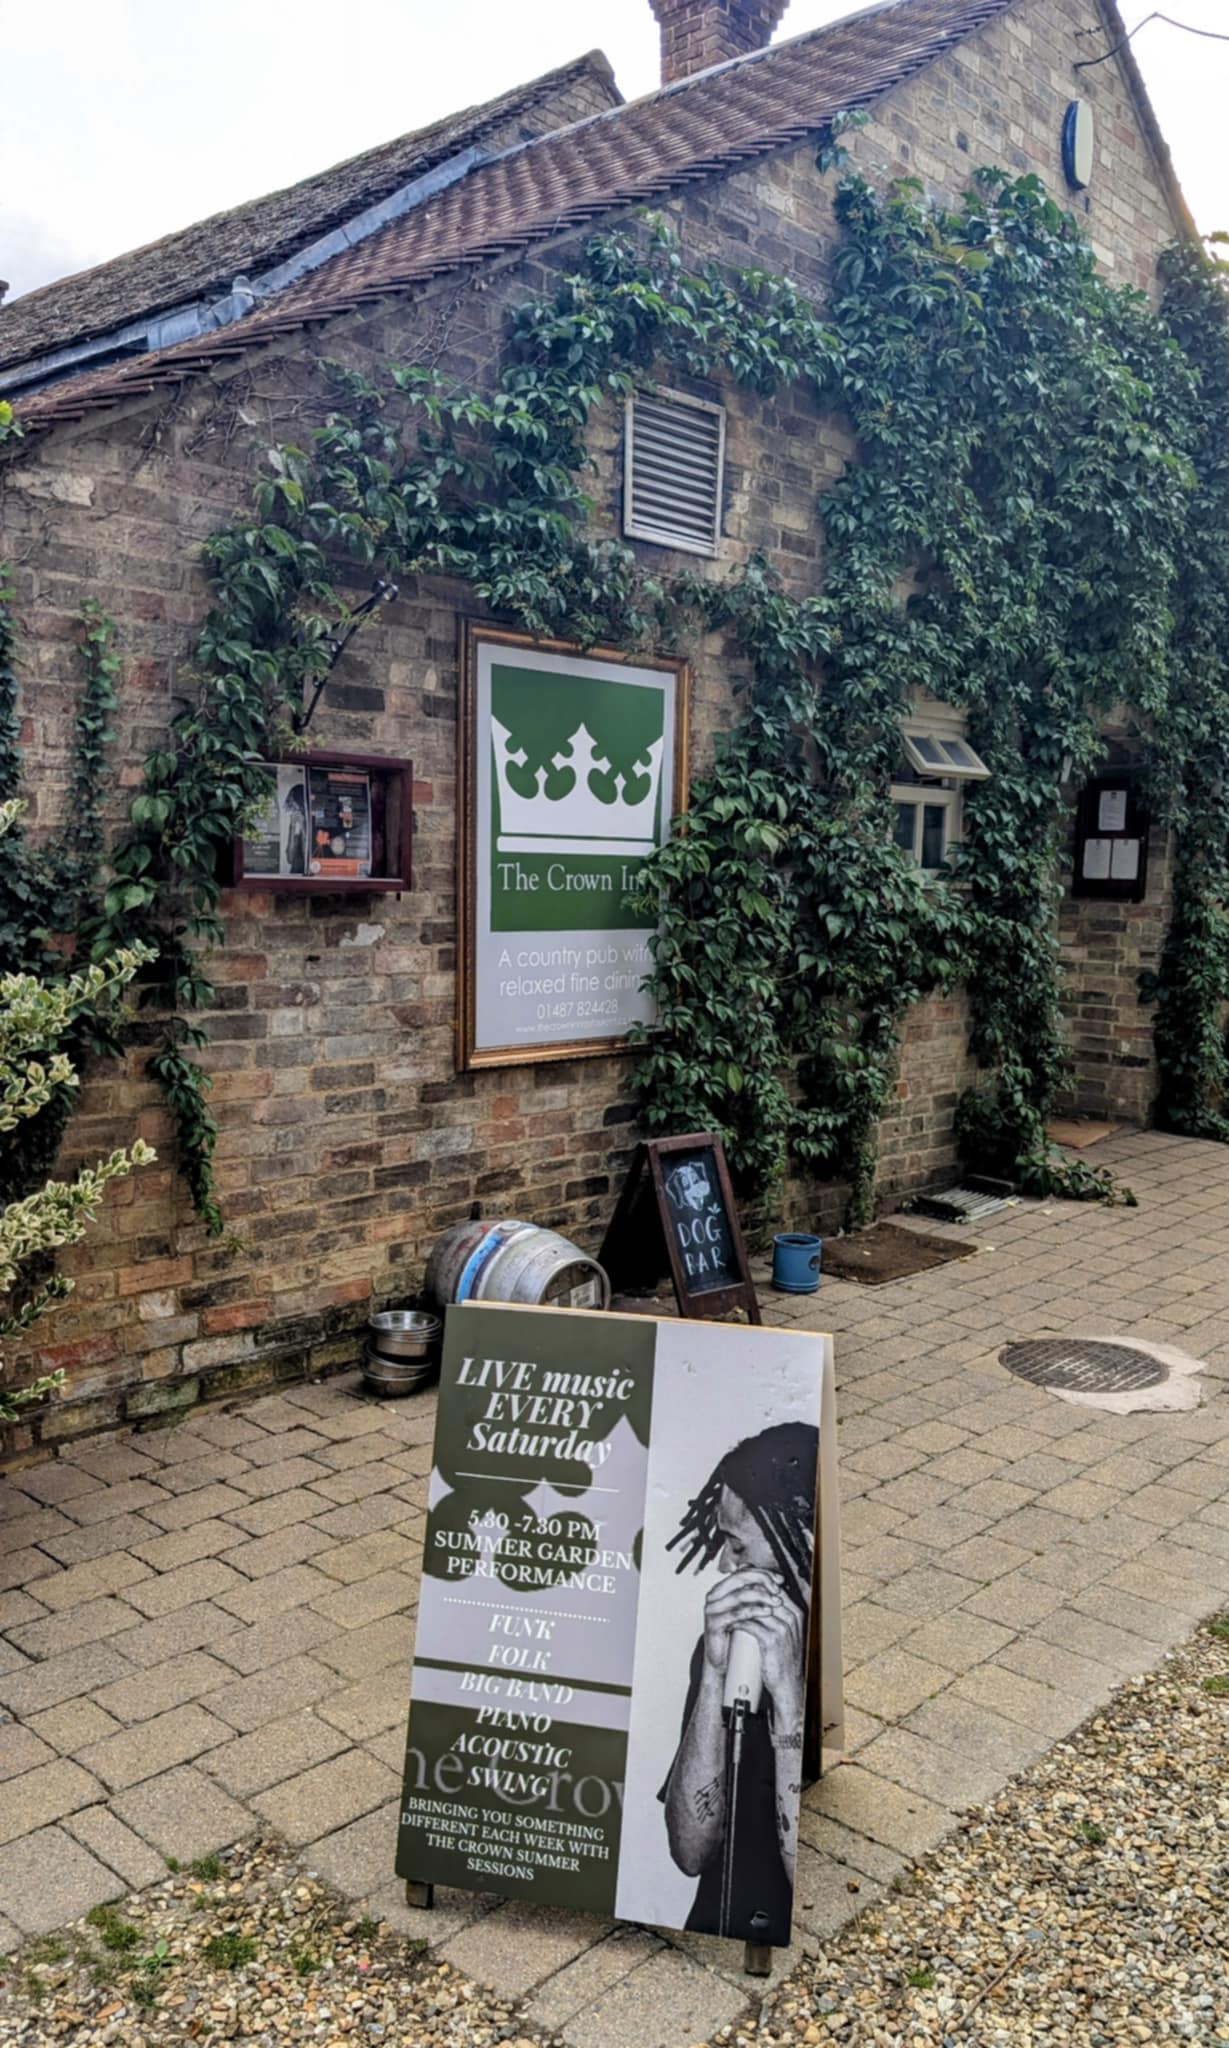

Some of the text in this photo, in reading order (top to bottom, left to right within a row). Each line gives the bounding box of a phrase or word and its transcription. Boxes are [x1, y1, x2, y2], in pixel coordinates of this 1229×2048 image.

[497, 862, 641, 891] The Crown In
[498, 949, 512, 968] A
[516, 947, 581, 969] country
[586, 945, 618, 968] pub
[500, 969, 642, 996] relaxed fine dinin
[536, 999, 618, 1020] 01487 824428
[677, 1215, 723, 1247] DOG
[684, 1247, 726, 1276] BAR
[455, 1357, 635, 1400] LIVE music
[483, 1392, 603, 1429] EVERY
[466, 1422, 612, 1469] Saturday
[467, 1509, 509, 1529] 5.30
[567, 1521, 601, 1541] PM
[434, 1530, 633, 1570] SUMMER GARDEN
[447, 1556, 617, 1594] PERFORMANCE
[488, 1613, 556, 1640] FUNK
[487, 1644, 552, 1671] FOLK
[460, 1671, 574, 1705] BIG BAND
[476, 1705, 552, 1734] PIANO
[450, 1733, 572, 1769] ACOUSTIC
[467, 1766, 550, 1797] SWING
[409, 1797, 605, 1842] BRINGING YOU SOMETHING
[401, 1812, 609, 1860] DIFFERENT EACH WEEK WITH
[426, 1833, 581, 1872] THE CROWN SUMMER
[467, 1857, 535, 1881] SESSIONS
